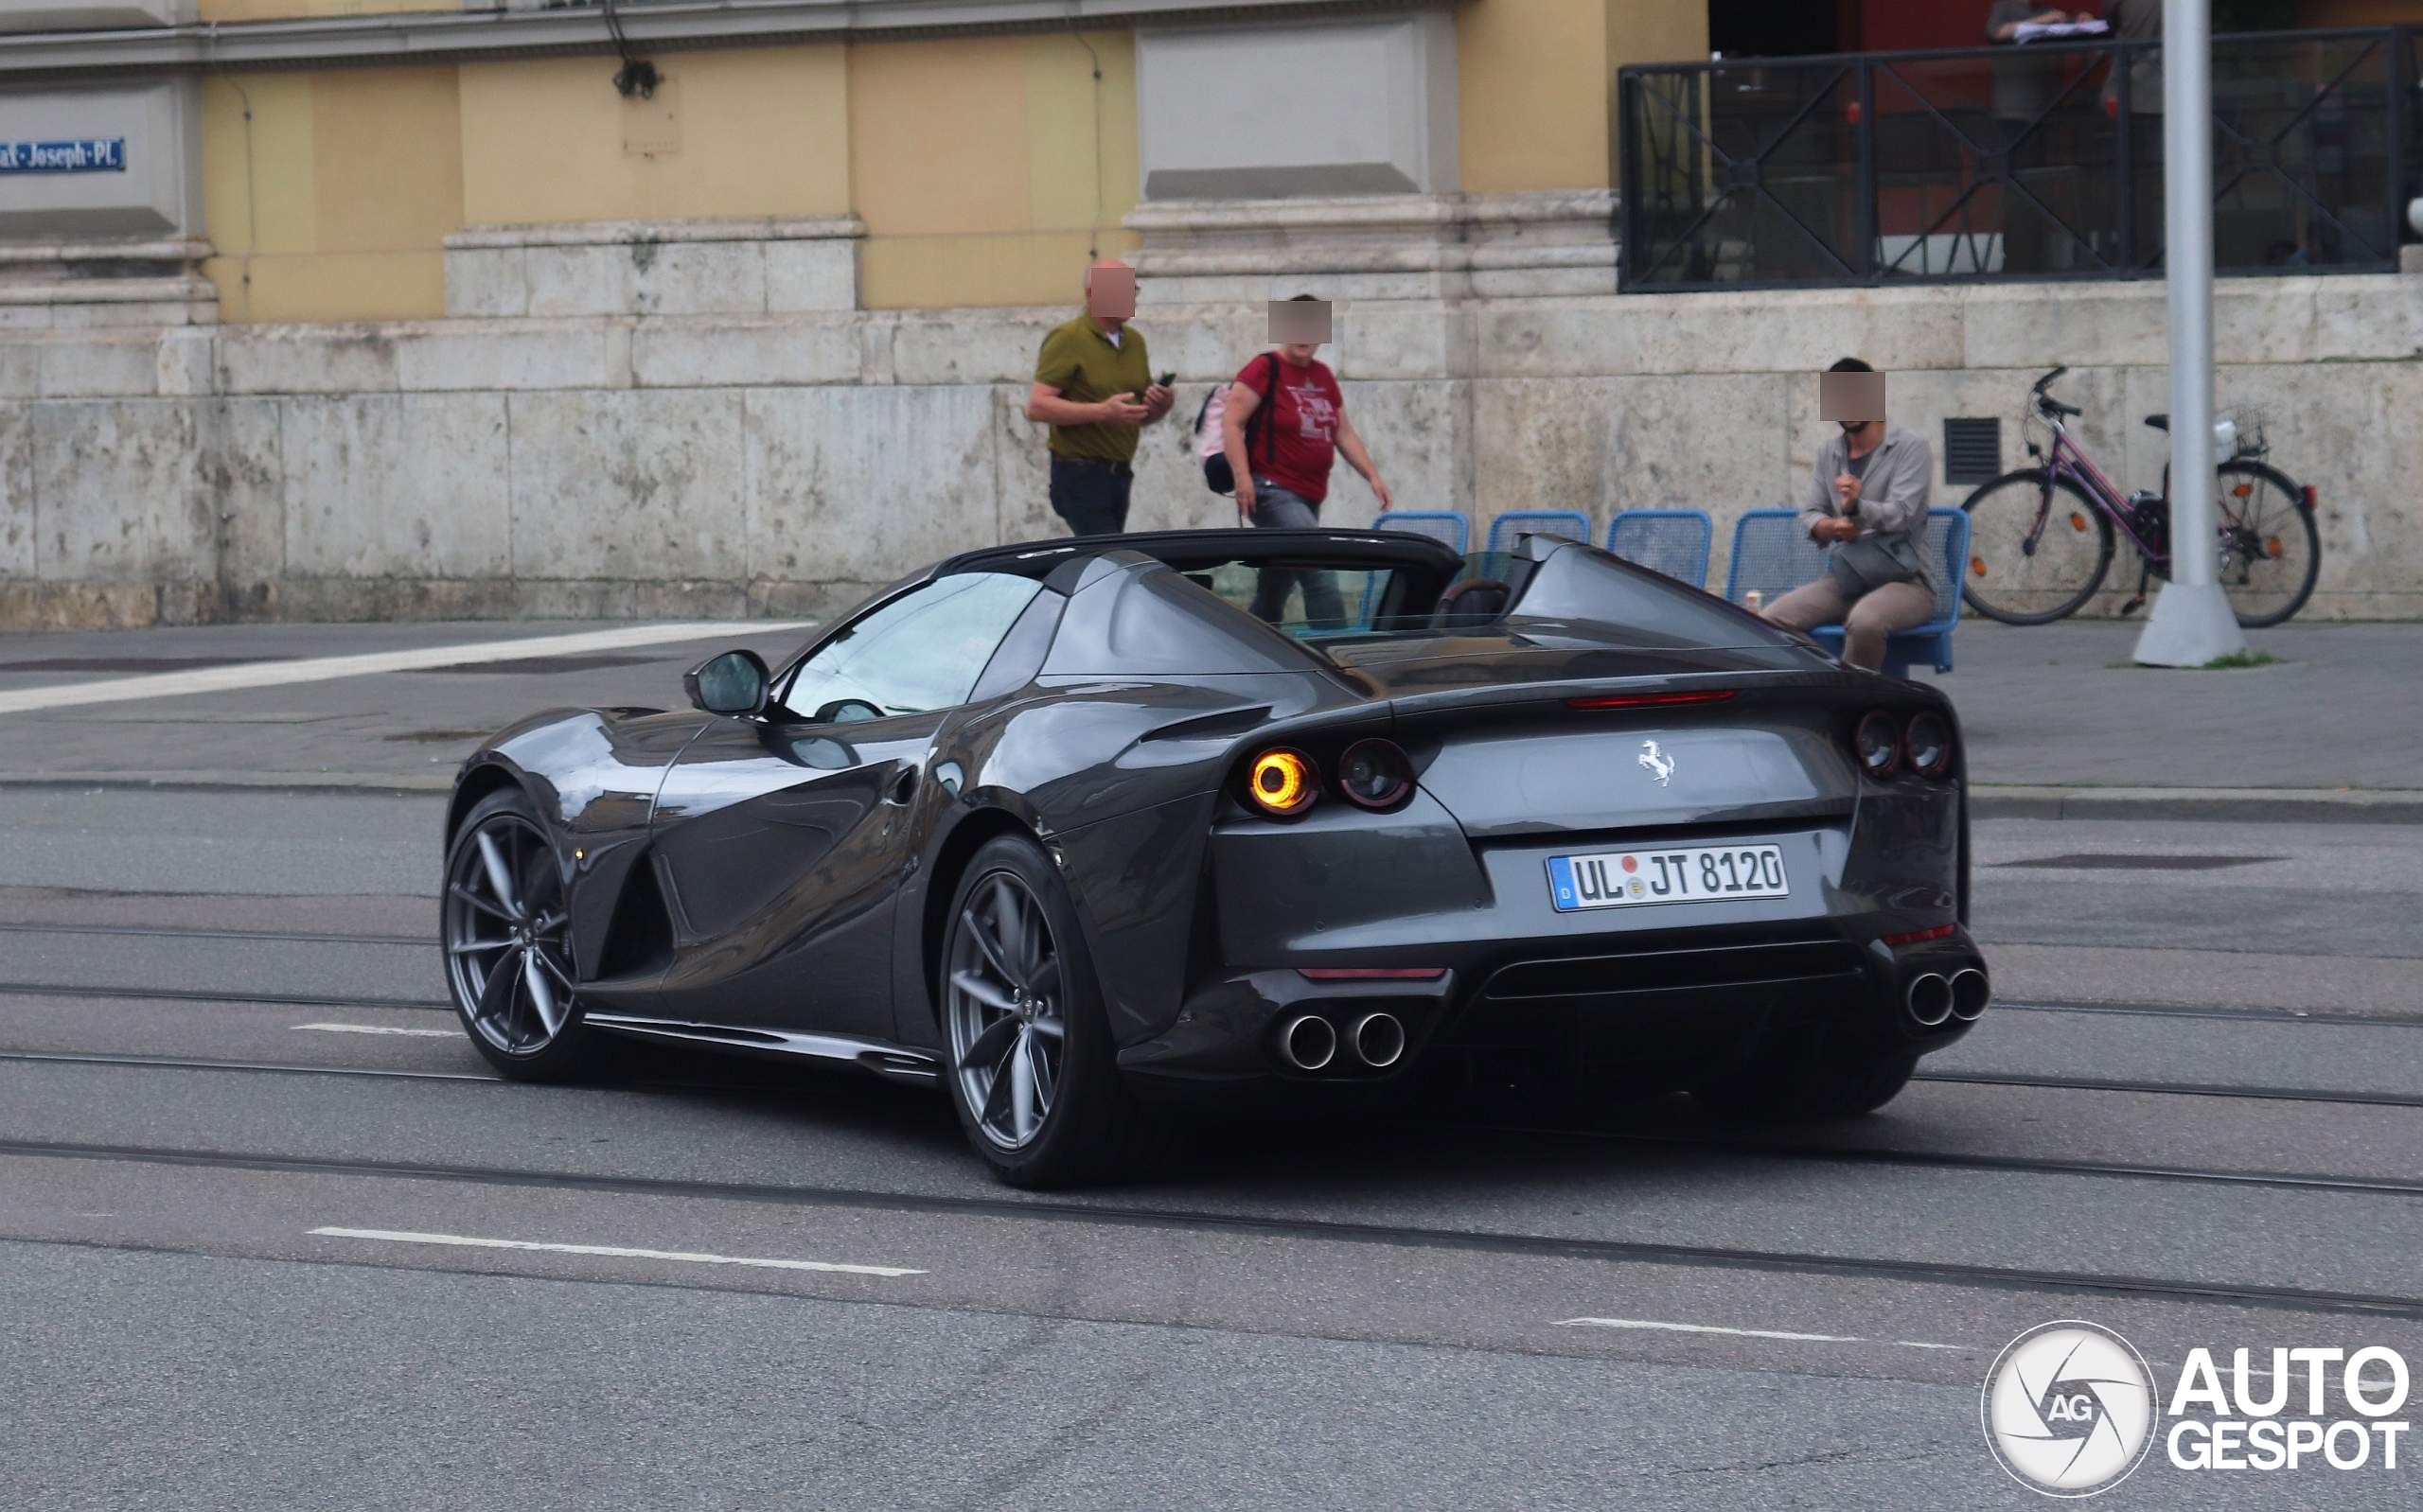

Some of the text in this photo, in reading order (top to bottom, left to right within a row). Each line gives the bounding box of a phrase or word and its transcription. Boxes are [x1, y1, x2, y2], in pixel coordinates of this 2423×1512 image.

[1575, 851, 1782, 900] UL JT 8120
[1561, 888, 1571, 900] D
